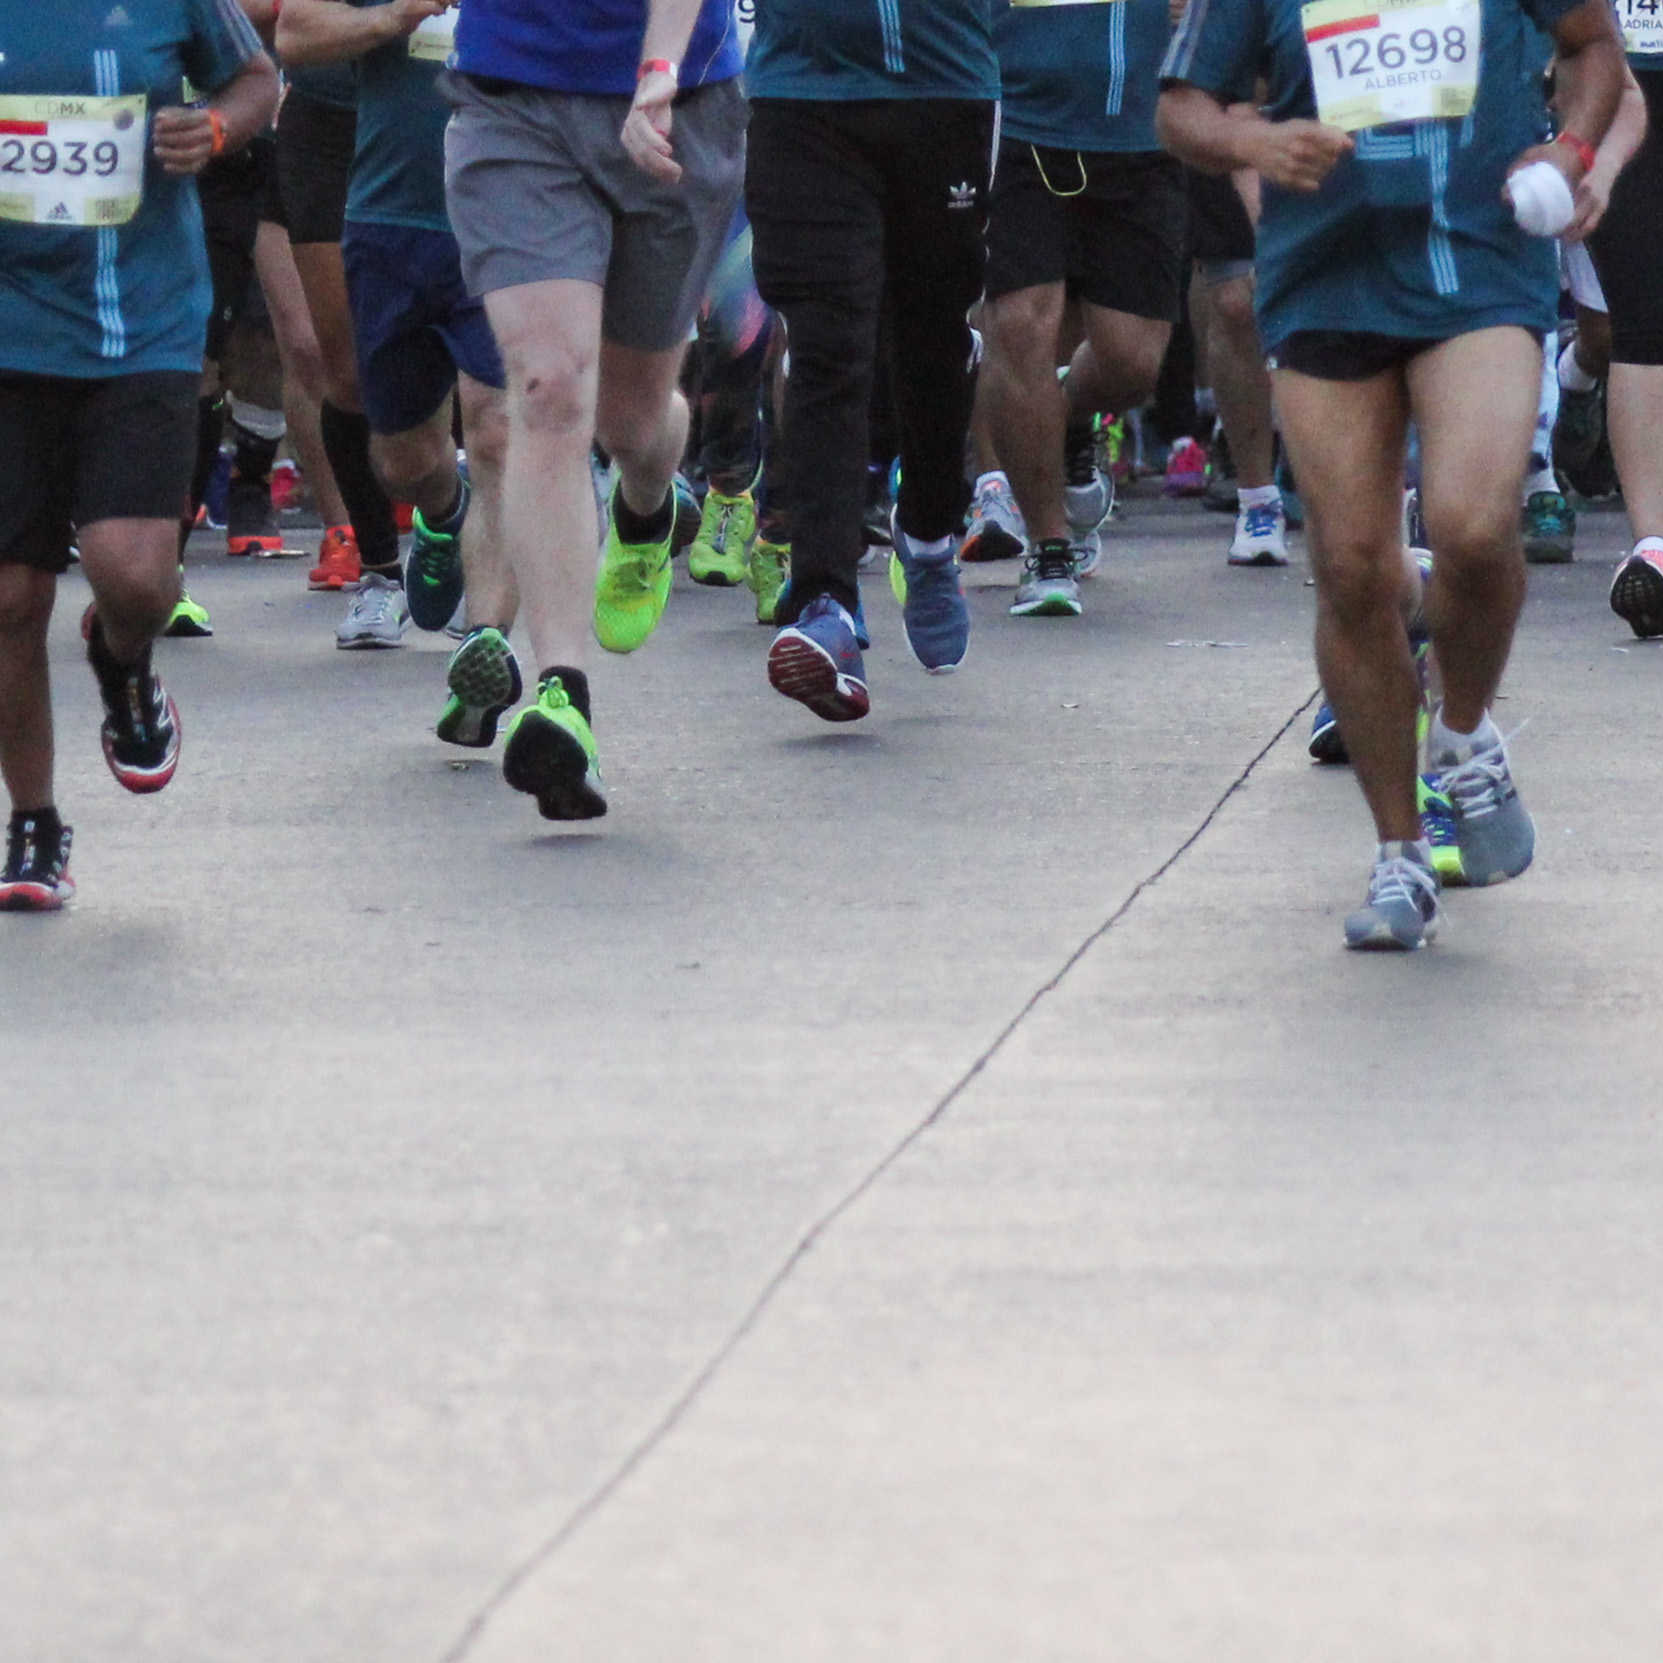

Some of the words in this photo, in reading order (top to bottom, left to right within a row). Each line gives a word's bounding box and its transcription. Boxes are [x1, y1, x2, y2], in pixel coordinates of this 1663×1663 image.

[1325, 25, 1468, 80] 12698
[1365, 69, 1444, 91] ALBERTO
[0, 139, 120, 177] 2939
